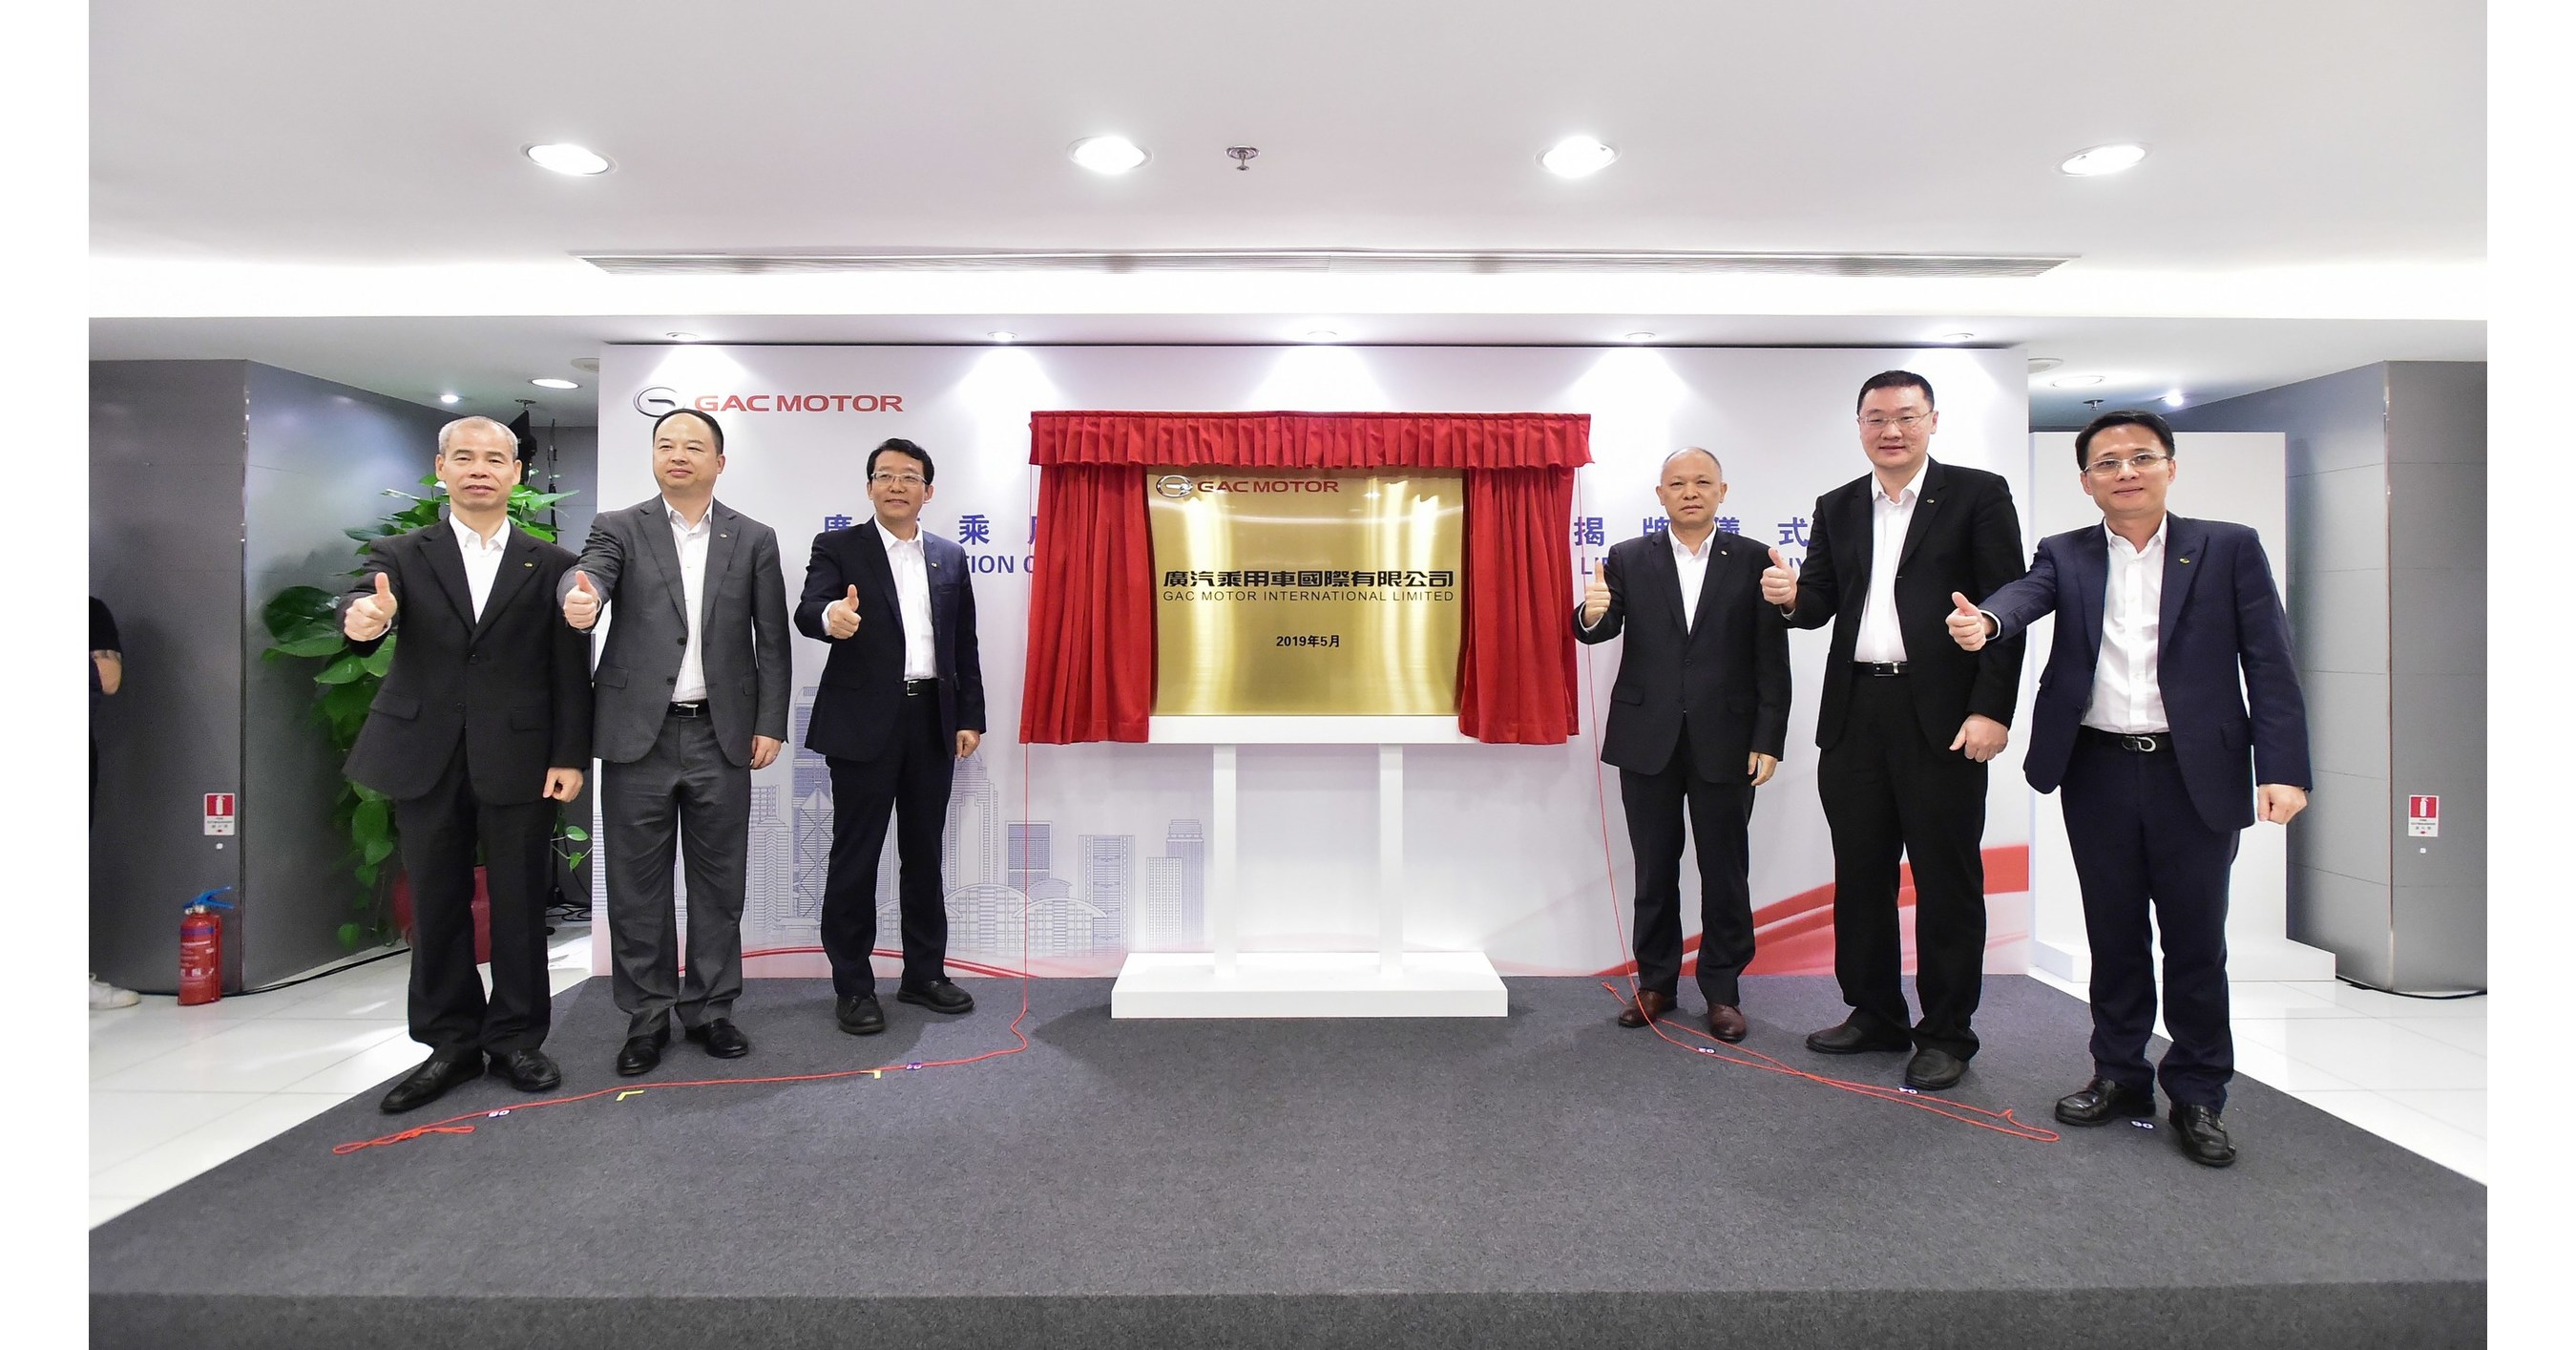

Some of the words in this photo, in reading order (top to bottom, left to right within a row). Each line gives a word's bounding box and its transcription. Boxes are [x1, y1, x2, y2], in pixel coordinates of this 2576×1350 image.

[694, 394, 770, 412] GAC
[776, 394, 904, 412] MOTOR
[1197, 480, 1249, 493] GAC
[1253, 480, 1340, 493] MOTOR
[965, 555, 1015, 574] ION
[1162, 570, 1455, 587] 廣汽乘用車國際有限公司
[1162, 590, 1195, 601] GAC
[1201, 590, 1257, 601] MOTOR
[1263, 590, 1387, 601] INTERNATIONAL
[1393, 590, 1455, 601] LIMITED
[1275, 635, 1341, 648] 2019年5月
